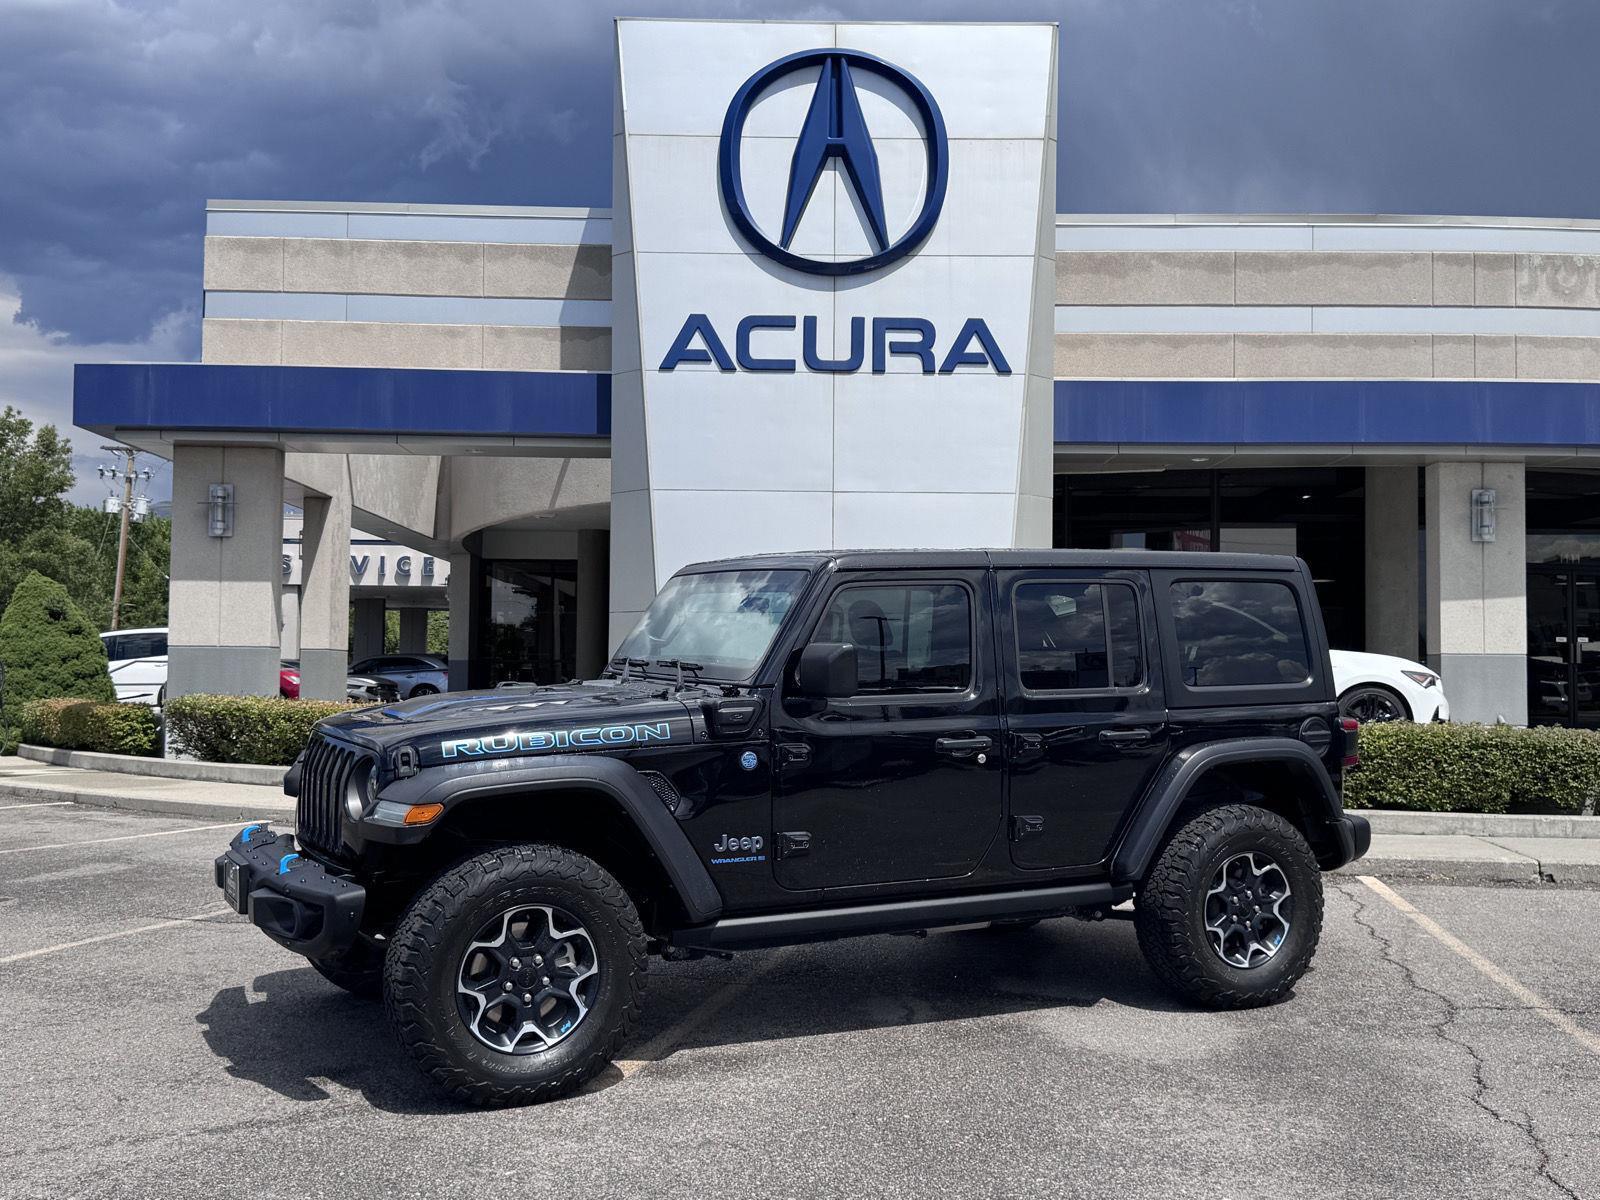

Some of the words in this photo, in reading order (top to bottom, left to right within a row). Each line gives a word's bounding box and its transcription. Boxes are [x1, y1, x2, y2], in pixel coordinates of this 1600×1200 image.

[658, 313, 1012, 375] ACURA
[283, 554, 435, 576] SVICE
[441, 723, 671, 758] RUBICON
[713, 834, 764, 853] Jeep
[710, 856, 757, 864] WRANGLER
